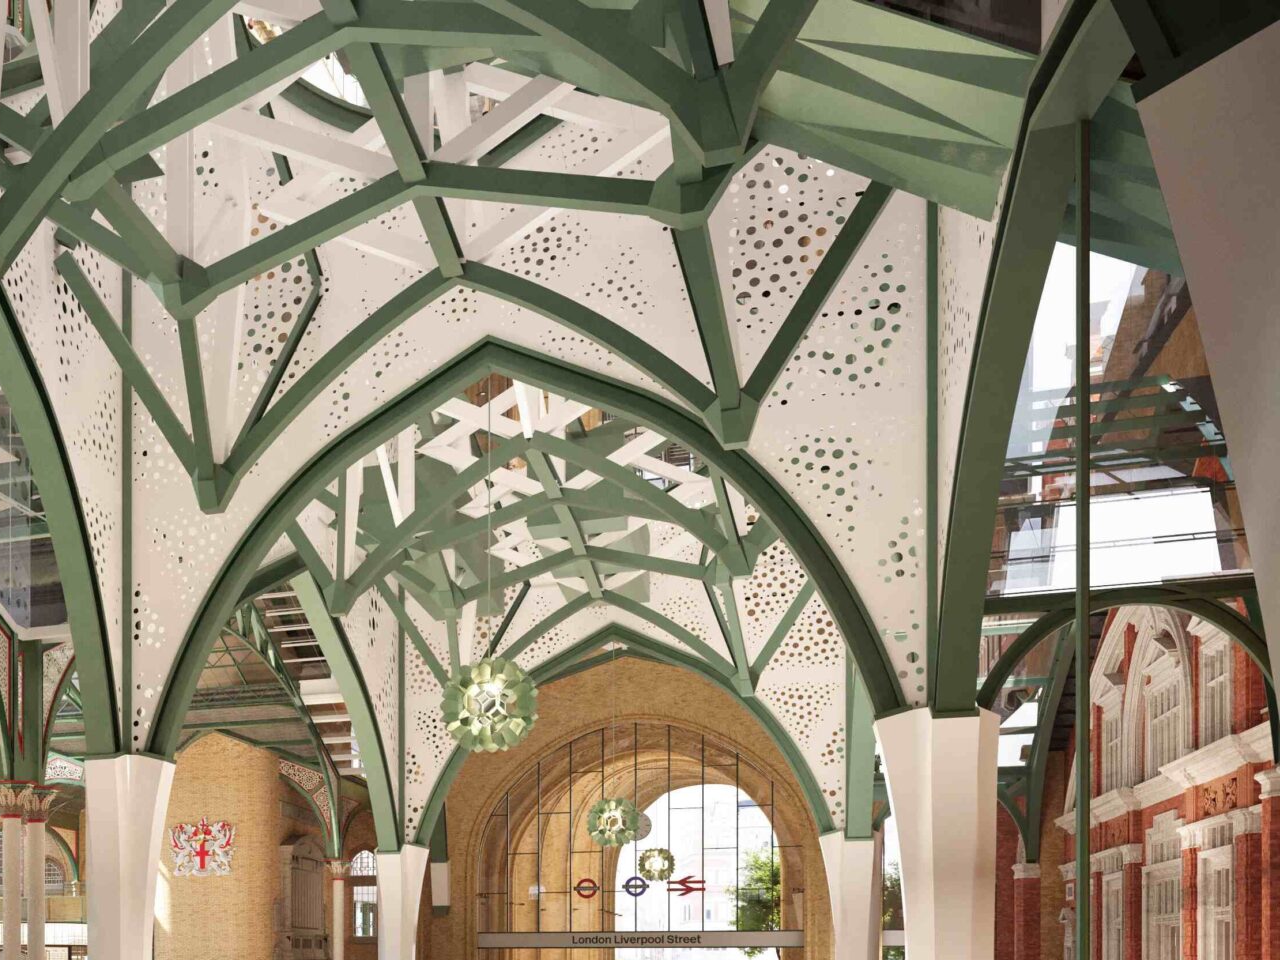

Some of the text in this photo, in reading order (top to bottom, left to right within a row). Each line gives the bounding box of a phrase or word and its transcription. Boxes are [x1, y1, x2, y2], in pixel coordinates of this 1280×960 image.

[572, 934, 702, 947] London Liverpool Street
